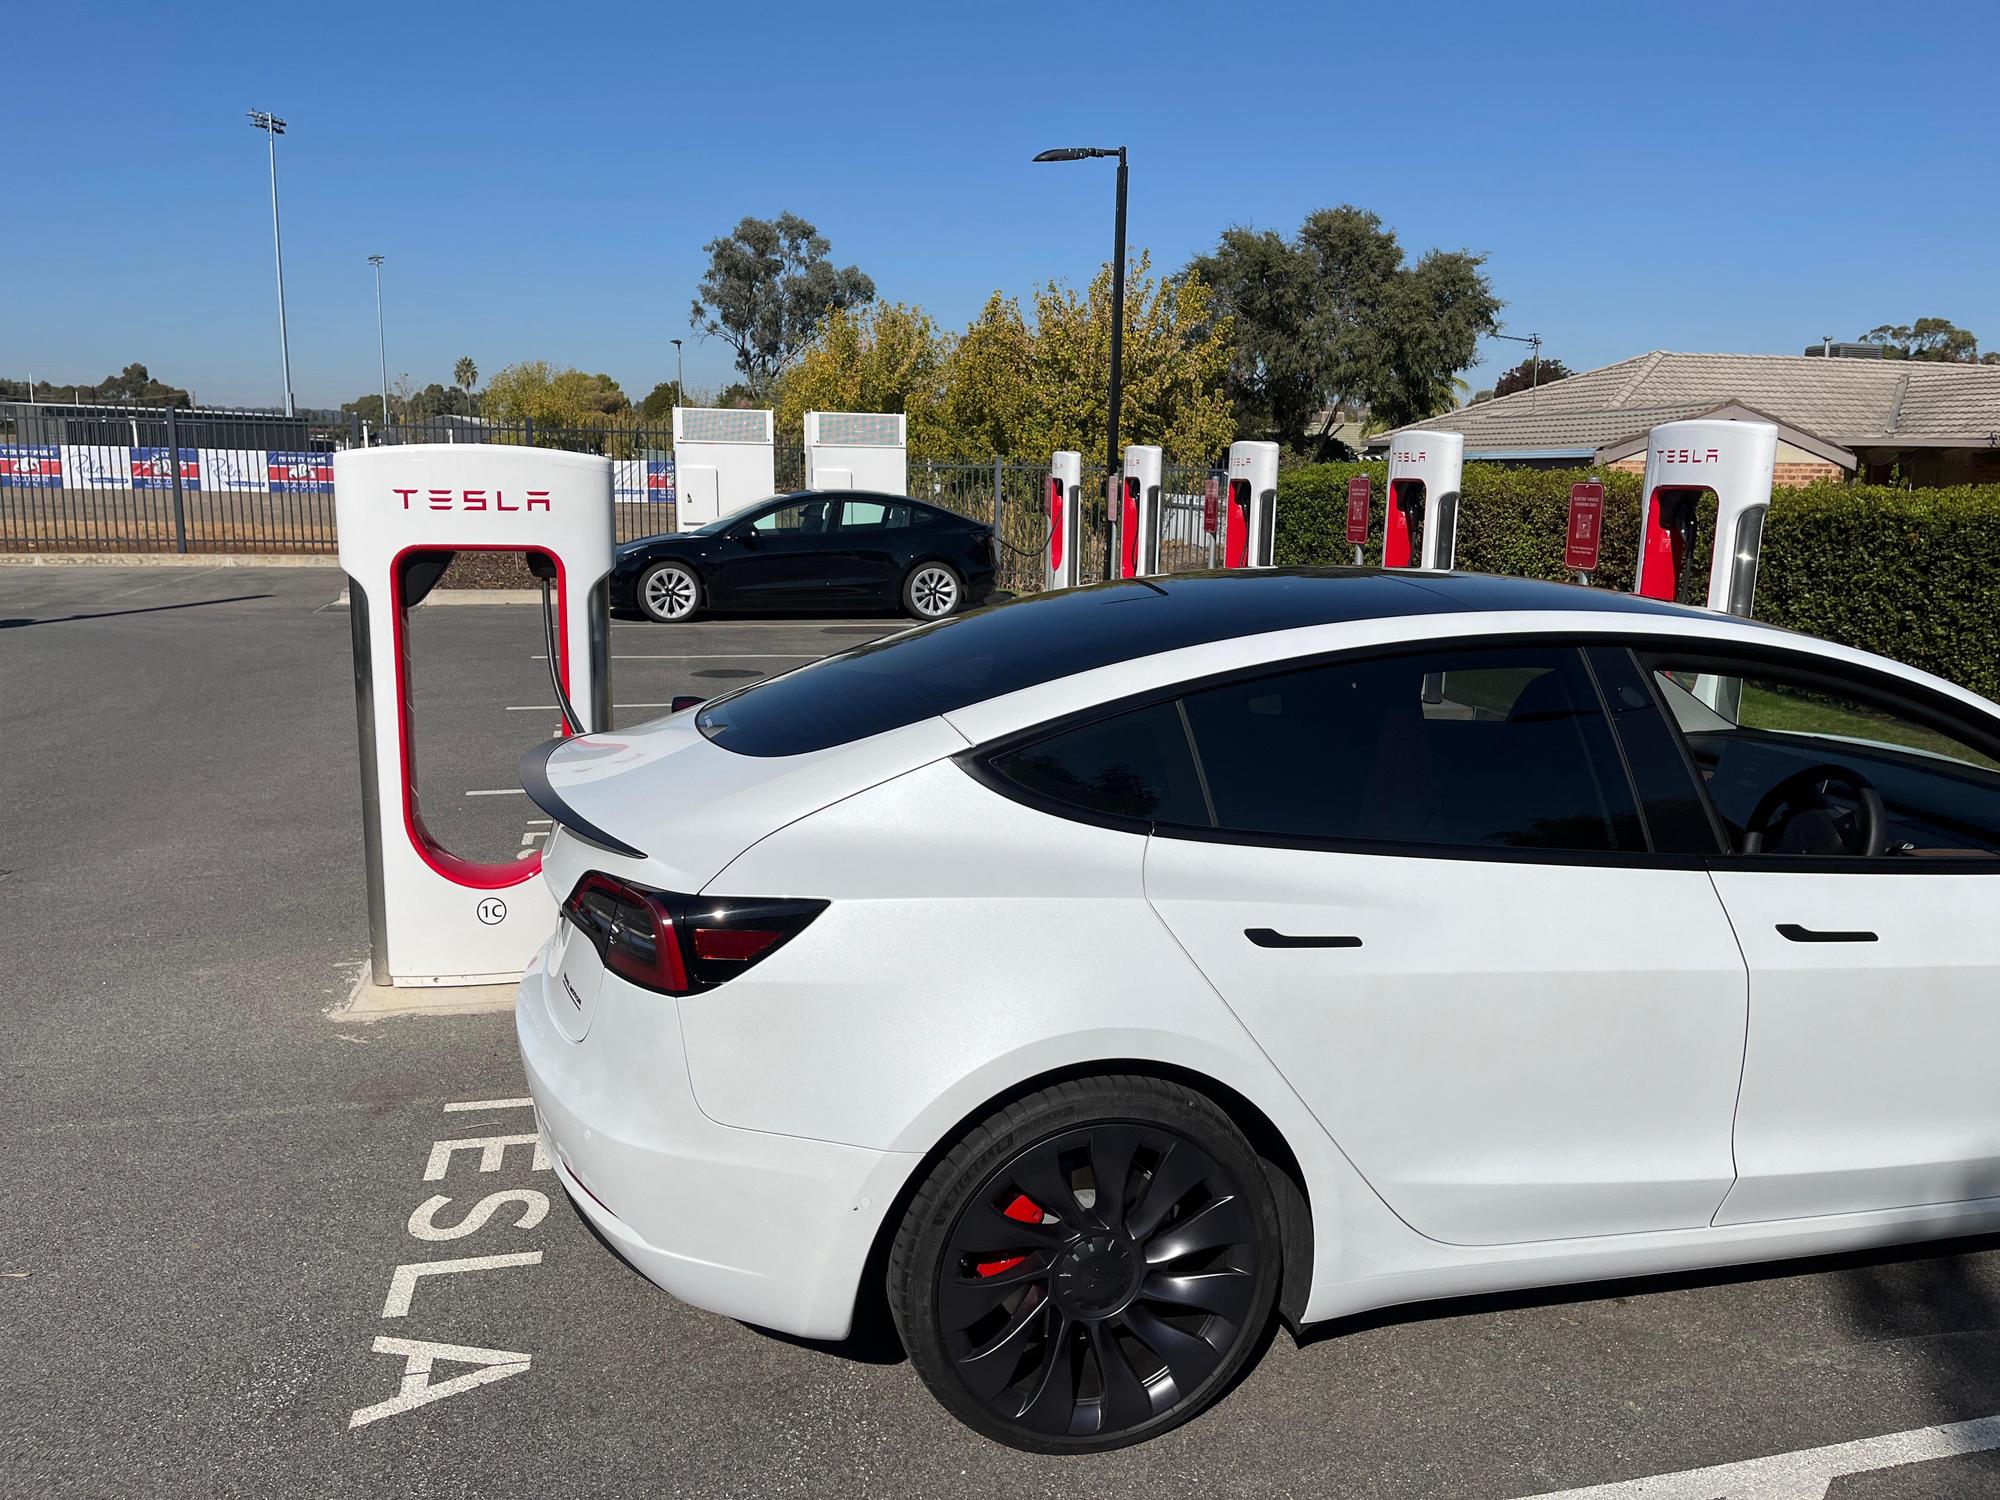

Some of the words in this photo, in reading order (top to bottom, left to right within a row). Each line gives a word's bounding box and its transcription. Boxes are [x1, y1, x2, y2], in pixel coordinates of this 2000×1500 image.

[1392, 451, 1427, 463] TESLA
[1656, 449, 1719, 463] TESLA
[392, 488, 551, 512] TESLA
[482, 904, 503, 918] 1C
